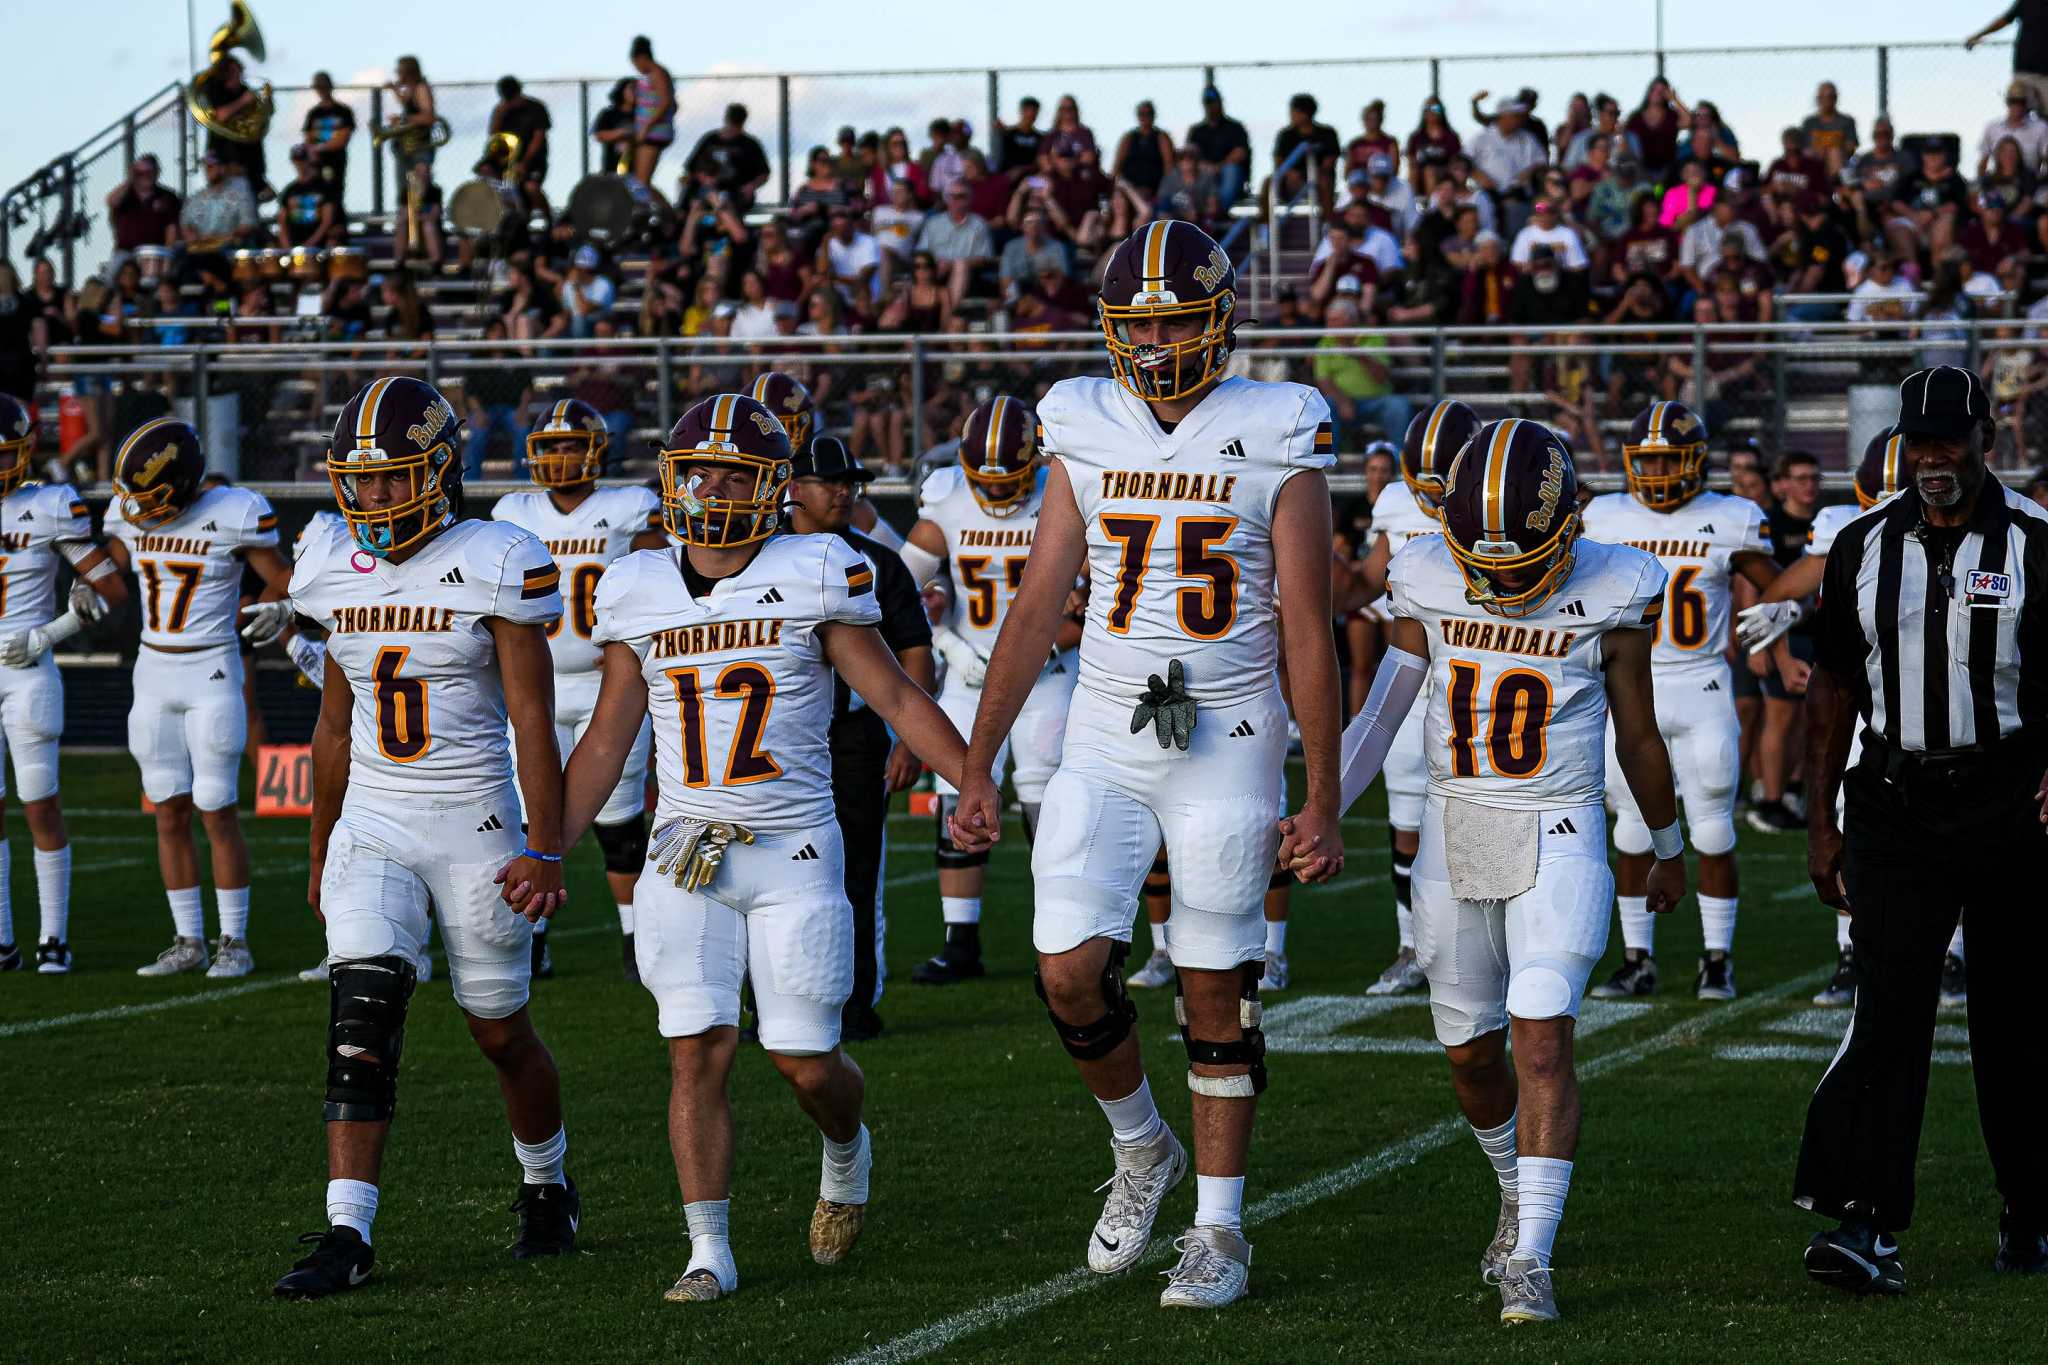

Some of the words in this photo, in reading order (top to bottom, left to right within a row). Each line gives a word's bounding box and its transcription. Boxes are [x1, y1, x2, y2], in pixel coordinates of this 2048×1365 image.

[1101, 470, 1237, 504] THORNDALE
[134, 535, 213, 556] THORNDALE
[960, 529, 1033, 547] THORNDAL
[139, 559, 205, 633] 17
[1099, 513, 1240, 640] 75
[331, 605, 457, 634] THORNDALE
[651, 619, 785, 659] THORNDALE
[1439, 617, 1578, 659] THORNDALE
[371, 644, 432, 763] 6
[664, 661, 784, 788] 12
[1446, 658, 1555, 779] 10
[259, 754, 313, 807] 40
